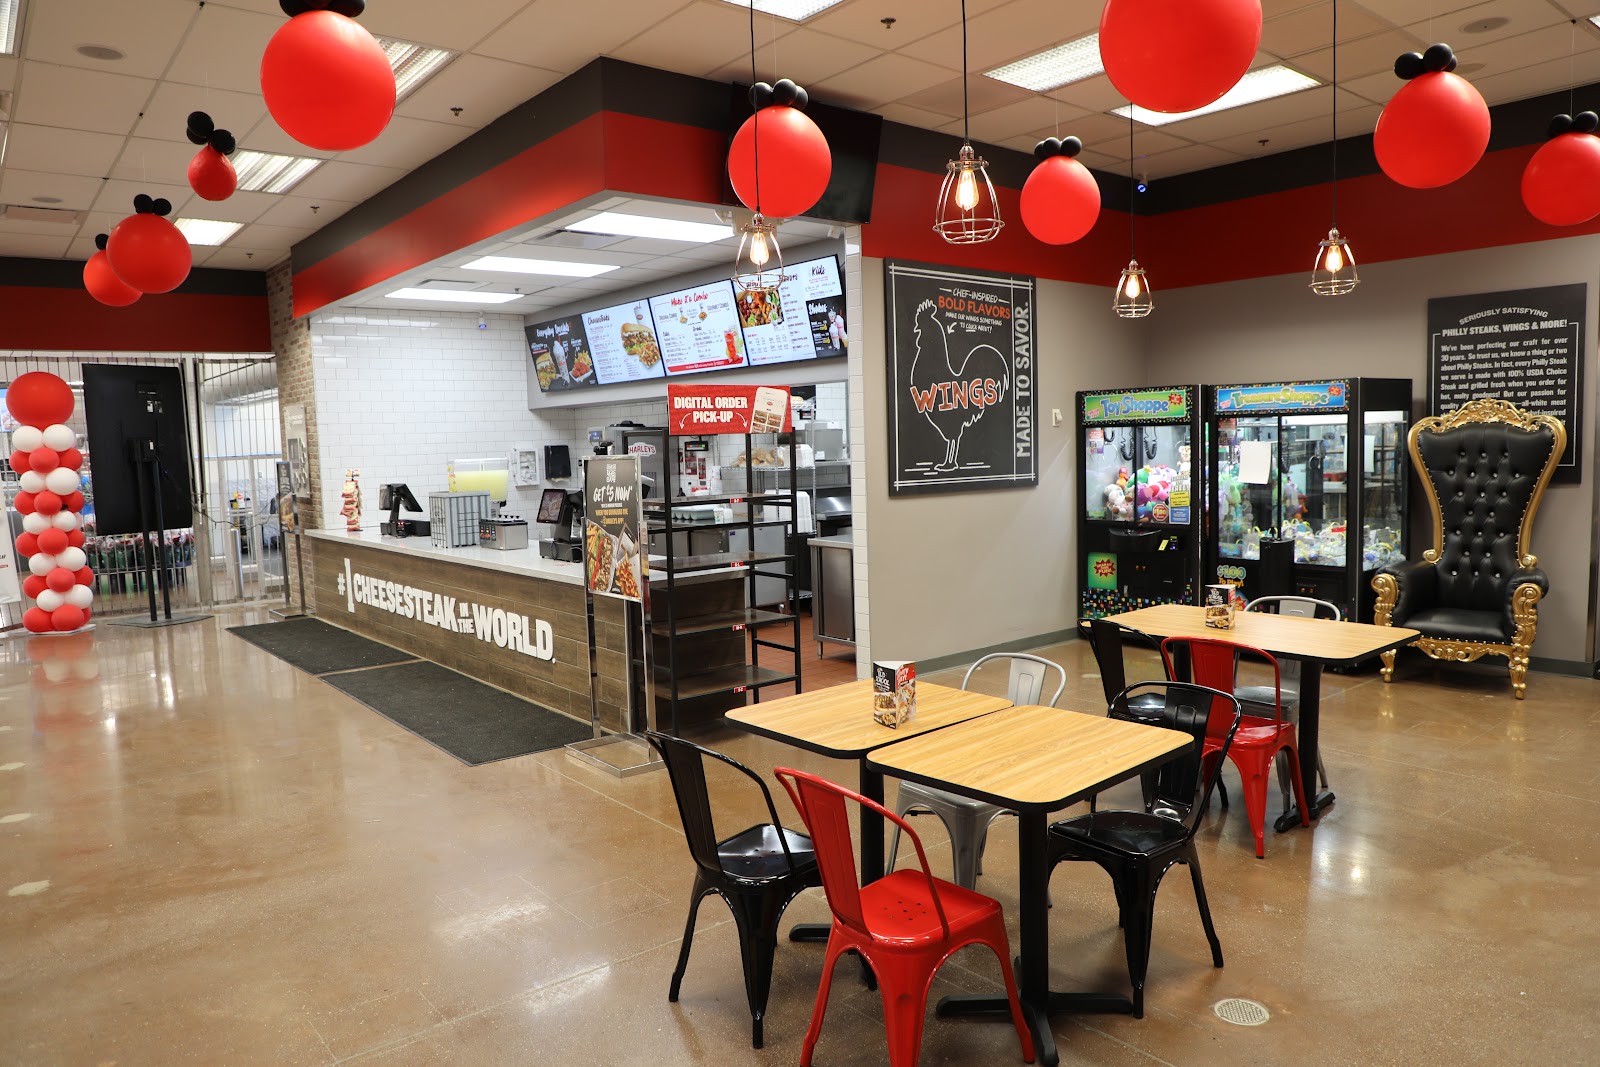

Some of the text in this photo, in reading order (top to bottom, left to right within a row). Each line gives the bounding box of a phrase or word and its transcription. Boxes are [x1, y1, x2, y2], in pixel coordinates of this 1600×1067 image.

[953, 288, 998, 303] CHEF-INSPIRED
[938, 296, 1010, 319] BOLD FLAVORS
[980, 317, 1002, 326] SOMETHING
[1459, 307, 1548, 325] SERIOUSLY SATISFYING
[1442, 328, 1468, 337] PHILLY
[1469, 325, 1501, 335] STEAKS,
[1503, 322, 1530, 332] WINGS
[1540, 319, 1568, 329] MORE!
[1477, 342, 1506, 350] perfecting
[1015, 302, 1030, 457] MADE TO SAVOR.
[1471, 382, 1488, 390] grilled
[674, 396, 748, 409] DIGITAL ORDER
[910, 378, 997, 413] WINGS
[1281, 387, 1329, 405] Shoppe
[1472, 391, 1500, 400] goodness!
[1530, 389, 1554, 397] passion
[1100, 398, 1120, 418] Toy
[1121, 395, 1170, 415] Shoppe
[692, 411, 734, 423] PICK-UP
[593, 486, 606, 502] GET
[1217, 565, 1246, 580] $1.00
[337, 558, 556, 664] #1 CHEESESTEAK IN THE WORLD.
